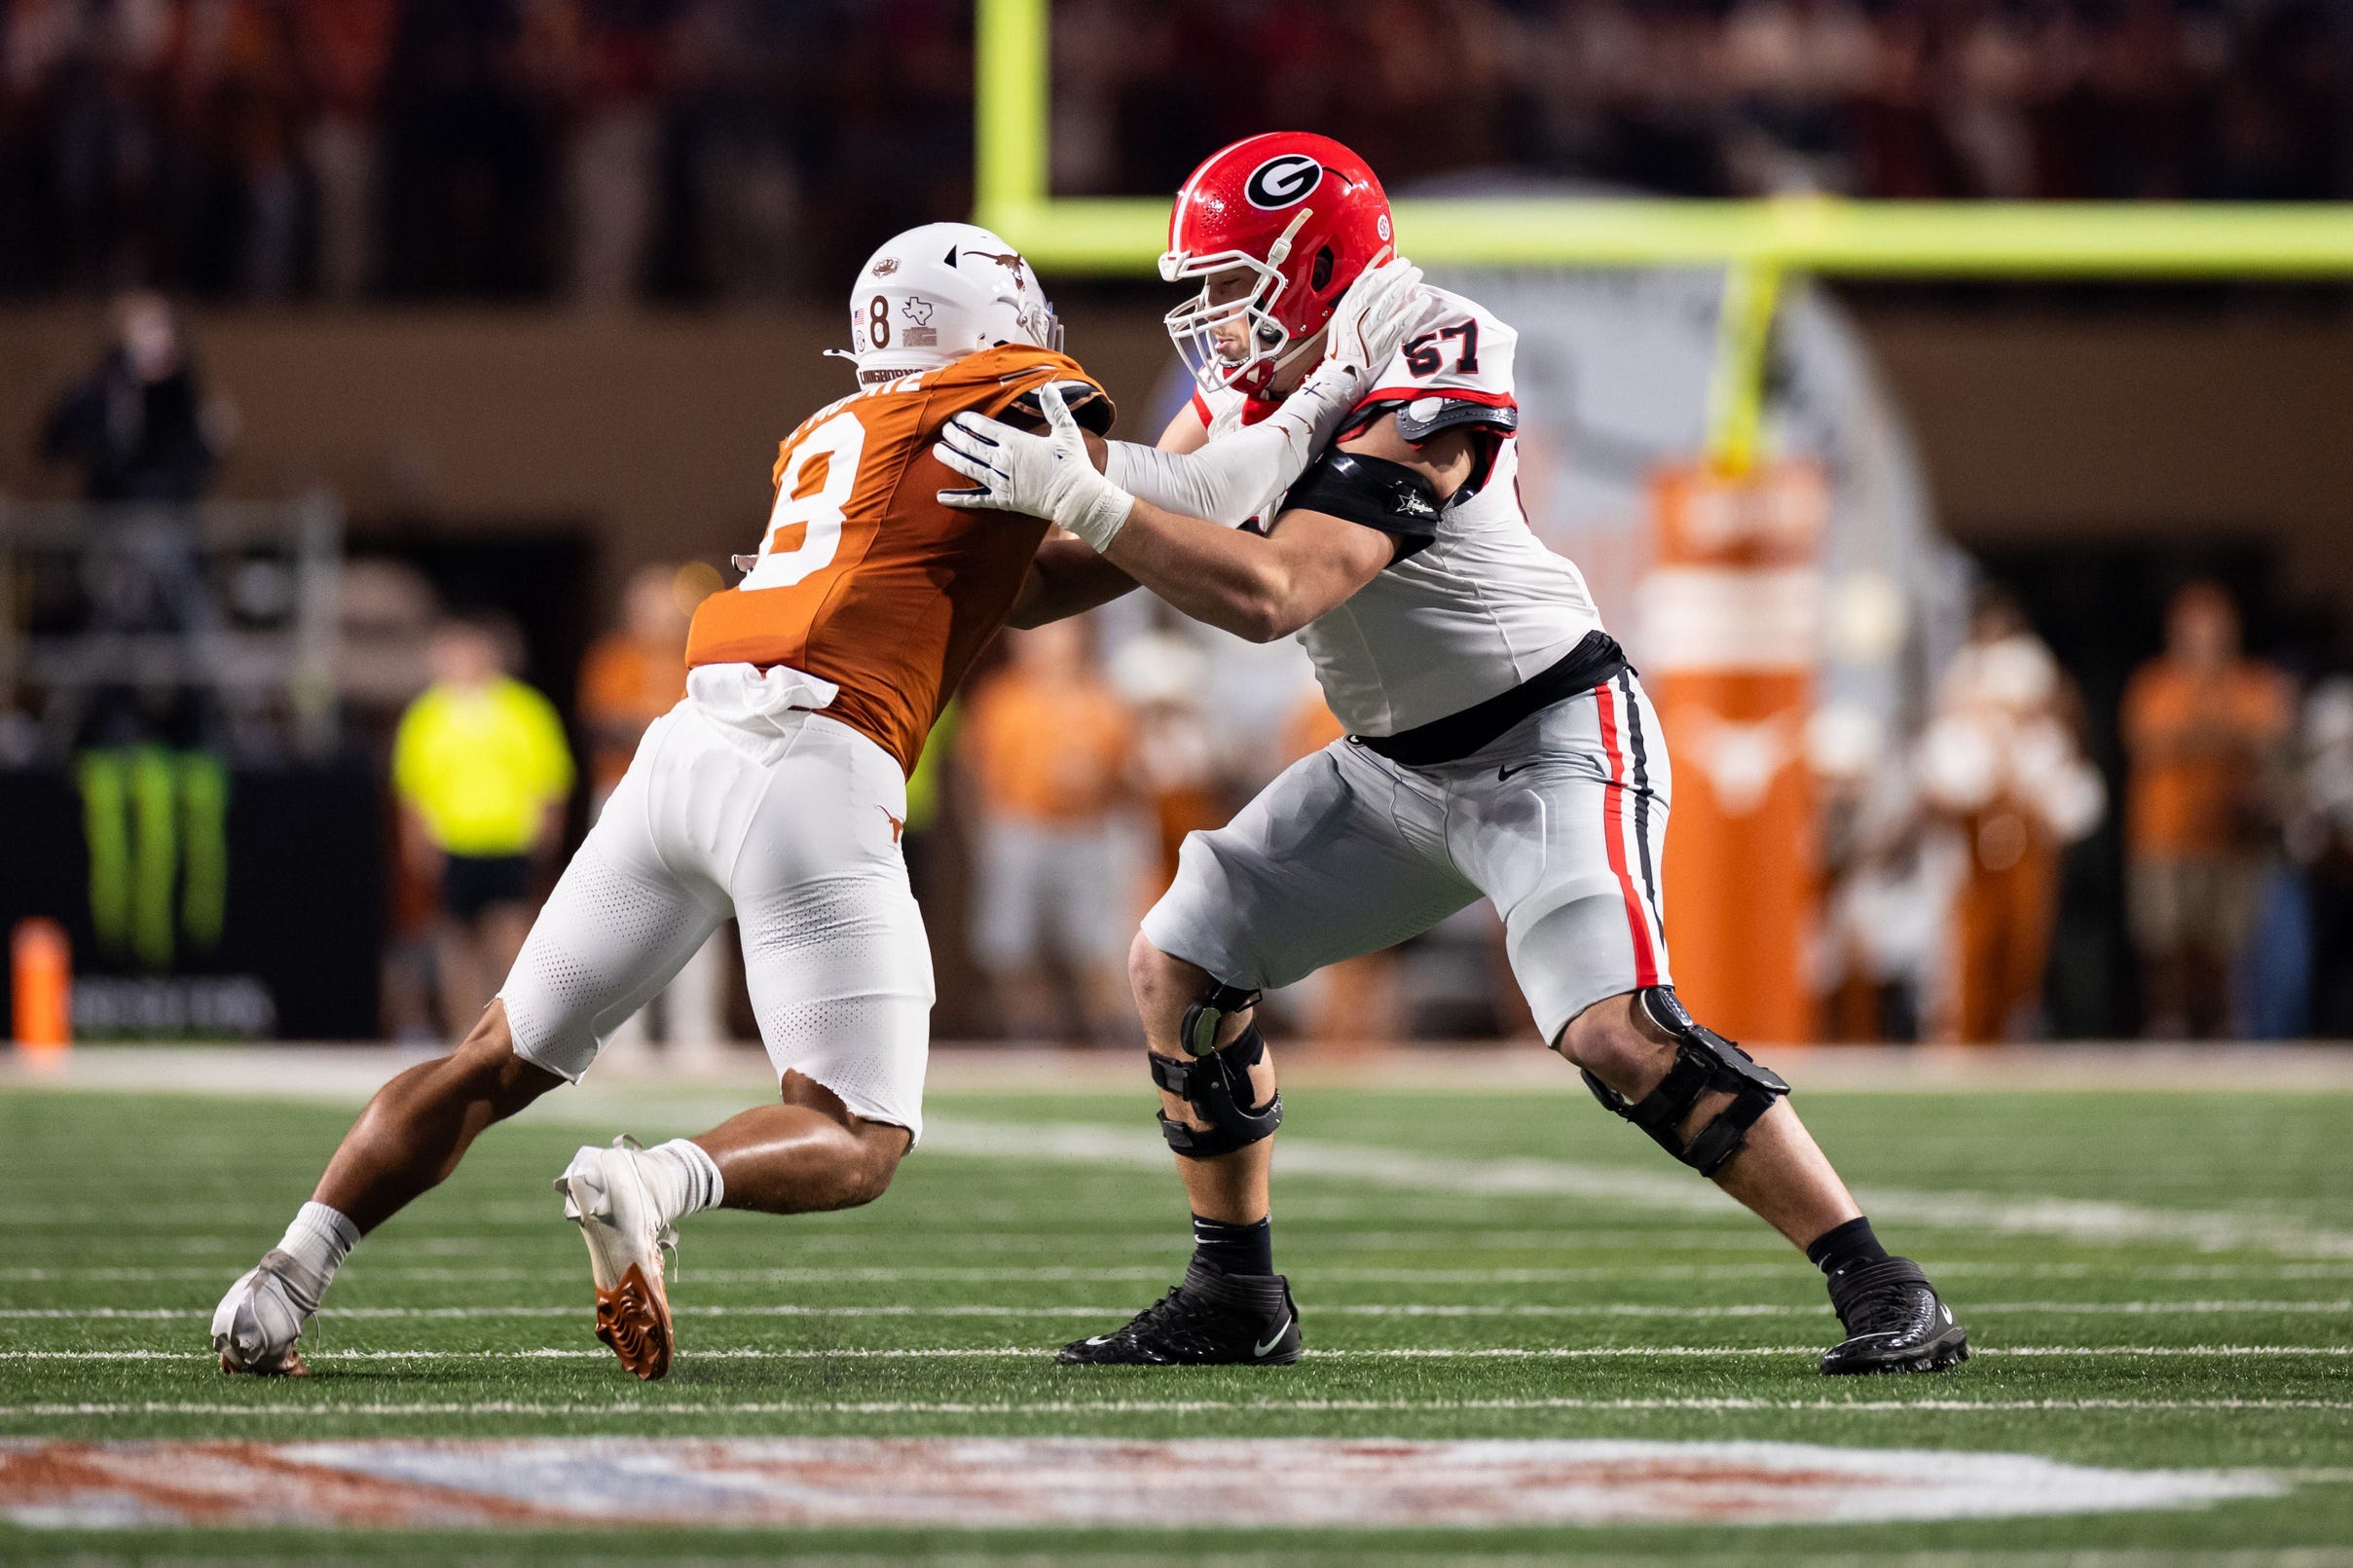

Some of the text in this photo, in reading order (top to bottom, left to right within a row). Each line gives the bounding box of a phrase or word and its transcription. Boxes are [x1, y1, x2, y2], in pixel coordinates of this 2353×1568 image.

[1247, 156, 1322, 209] G
[869, 295, 891, 349] 8
[1401, 317, 1479, 379] 57
[739, 411, 866, 592] 8
